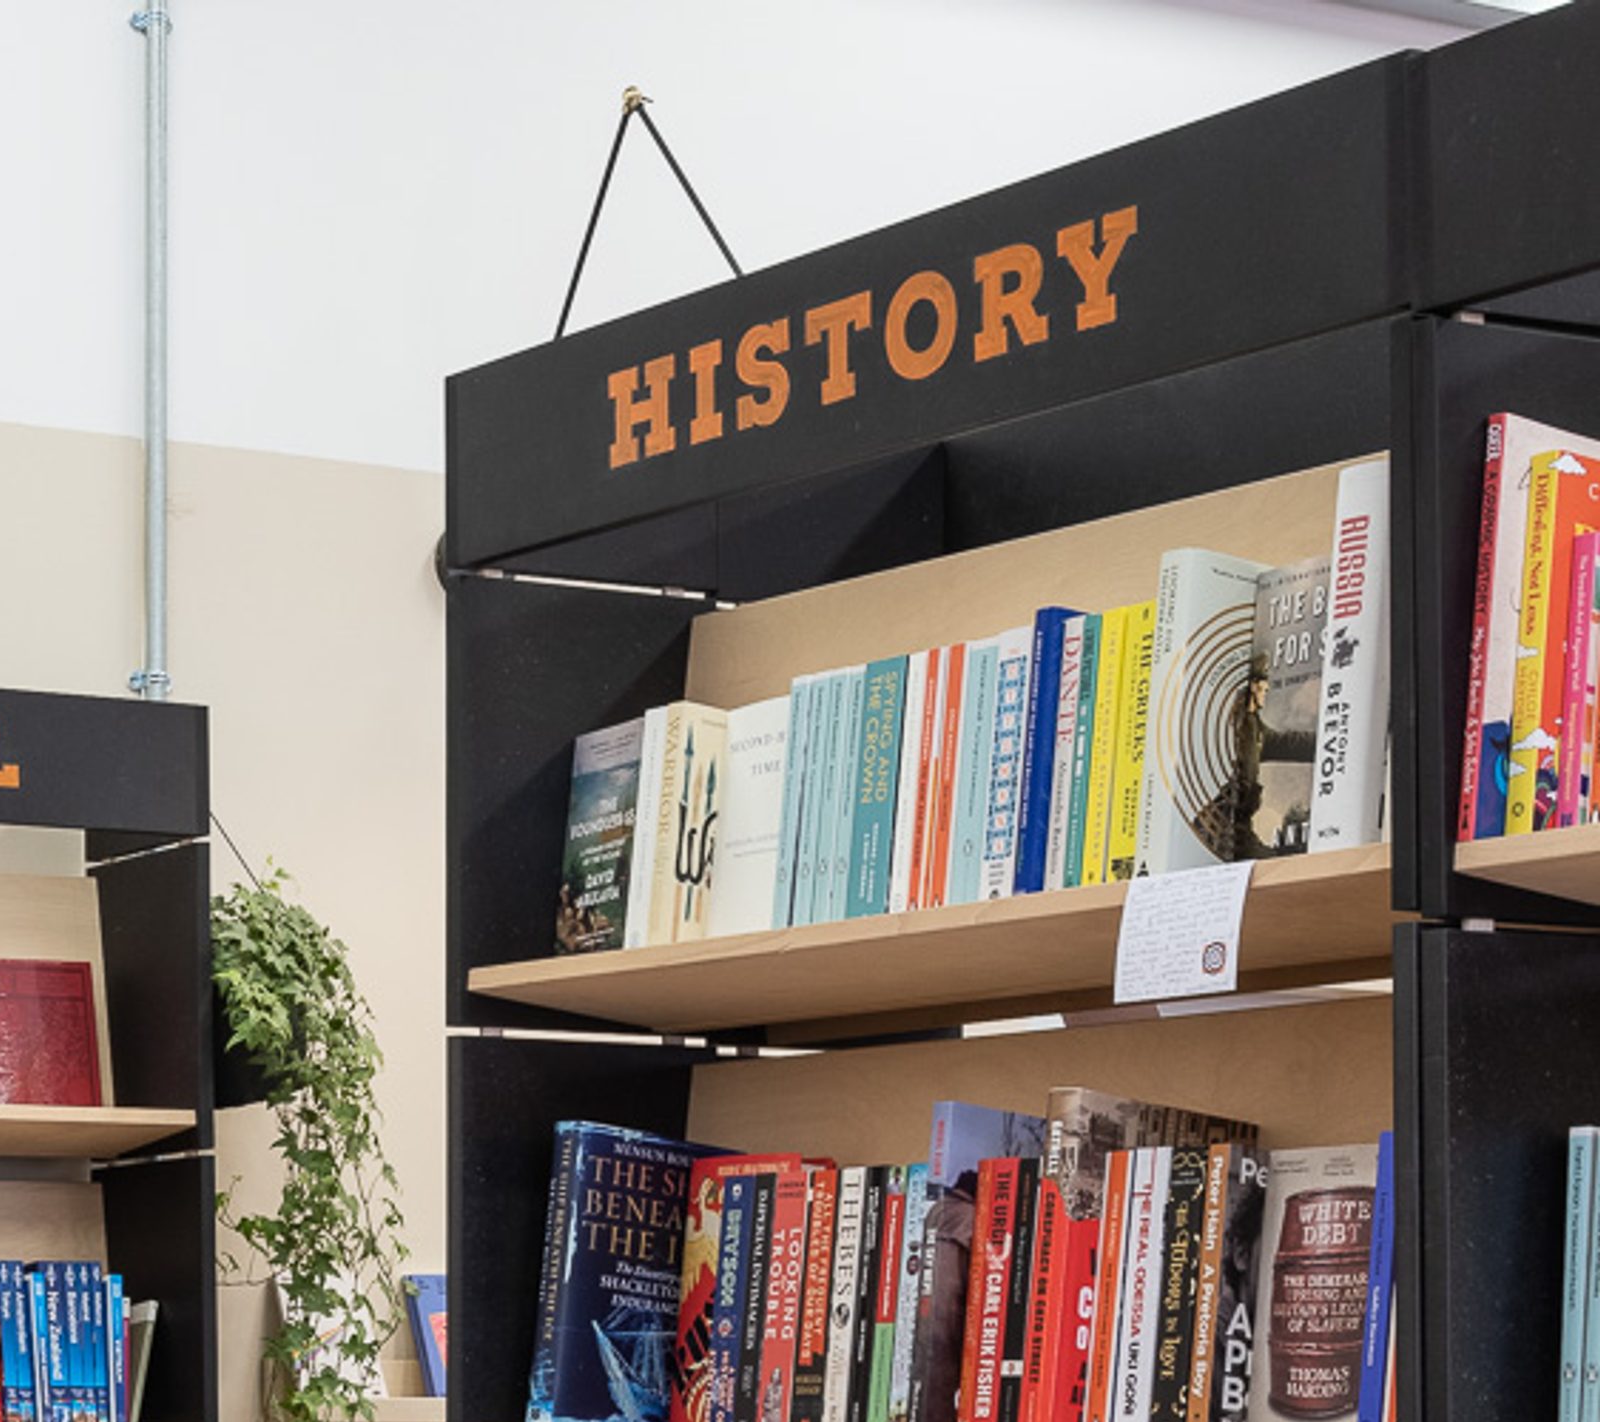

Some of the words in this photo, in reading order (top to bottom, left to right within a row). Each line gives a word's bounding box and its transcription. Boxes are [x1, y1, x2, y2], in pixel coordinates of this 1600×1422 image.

[607, 204, 1138, 469] HISTORY
[1334, 514, 1370, 620] RUSSIA
[1268, 592, 1304, 627] THE
[1273, 635, 1312, 668] FOR
[1056, 635, 1081, 750] DANTE
[1318, 682, 1342, 799] BEEVOR
[1335, 702, 1352, 775] ANTONY
[587, 1153, 655, 1190] THE
[1206, 1155, 1223, 1205] Peter
[1204, 1210, 1221, 1251] Hain
[1299, 1200, 1371, 1222] WHITE
[582, 1220, 665, 1261] THE
[836, 1176, 861, 1297] THEBES
[1302, 1224, 1363, 1245] DEBT
[720, 1209, 742, 1307] BRYSON
[1203, 1263, 1215, 1278] A
[765, 1229, 785, 1340] TROUBLE
[782, 1227, 800, 1340] LOOKING
[983, 1274, 1001, 1314] CARL
[980, 1318, 998, 1355] ERIK
[1196, 1283, 1213, 1356] Pretoria
[974, 1360, 995, 1418] FISHER
[1191, 1361, 1206, 1398] Boy
[1286, 1380, 1350, 1398] HARDING
[1288, 1365, 1350, 1382] THOMAS
